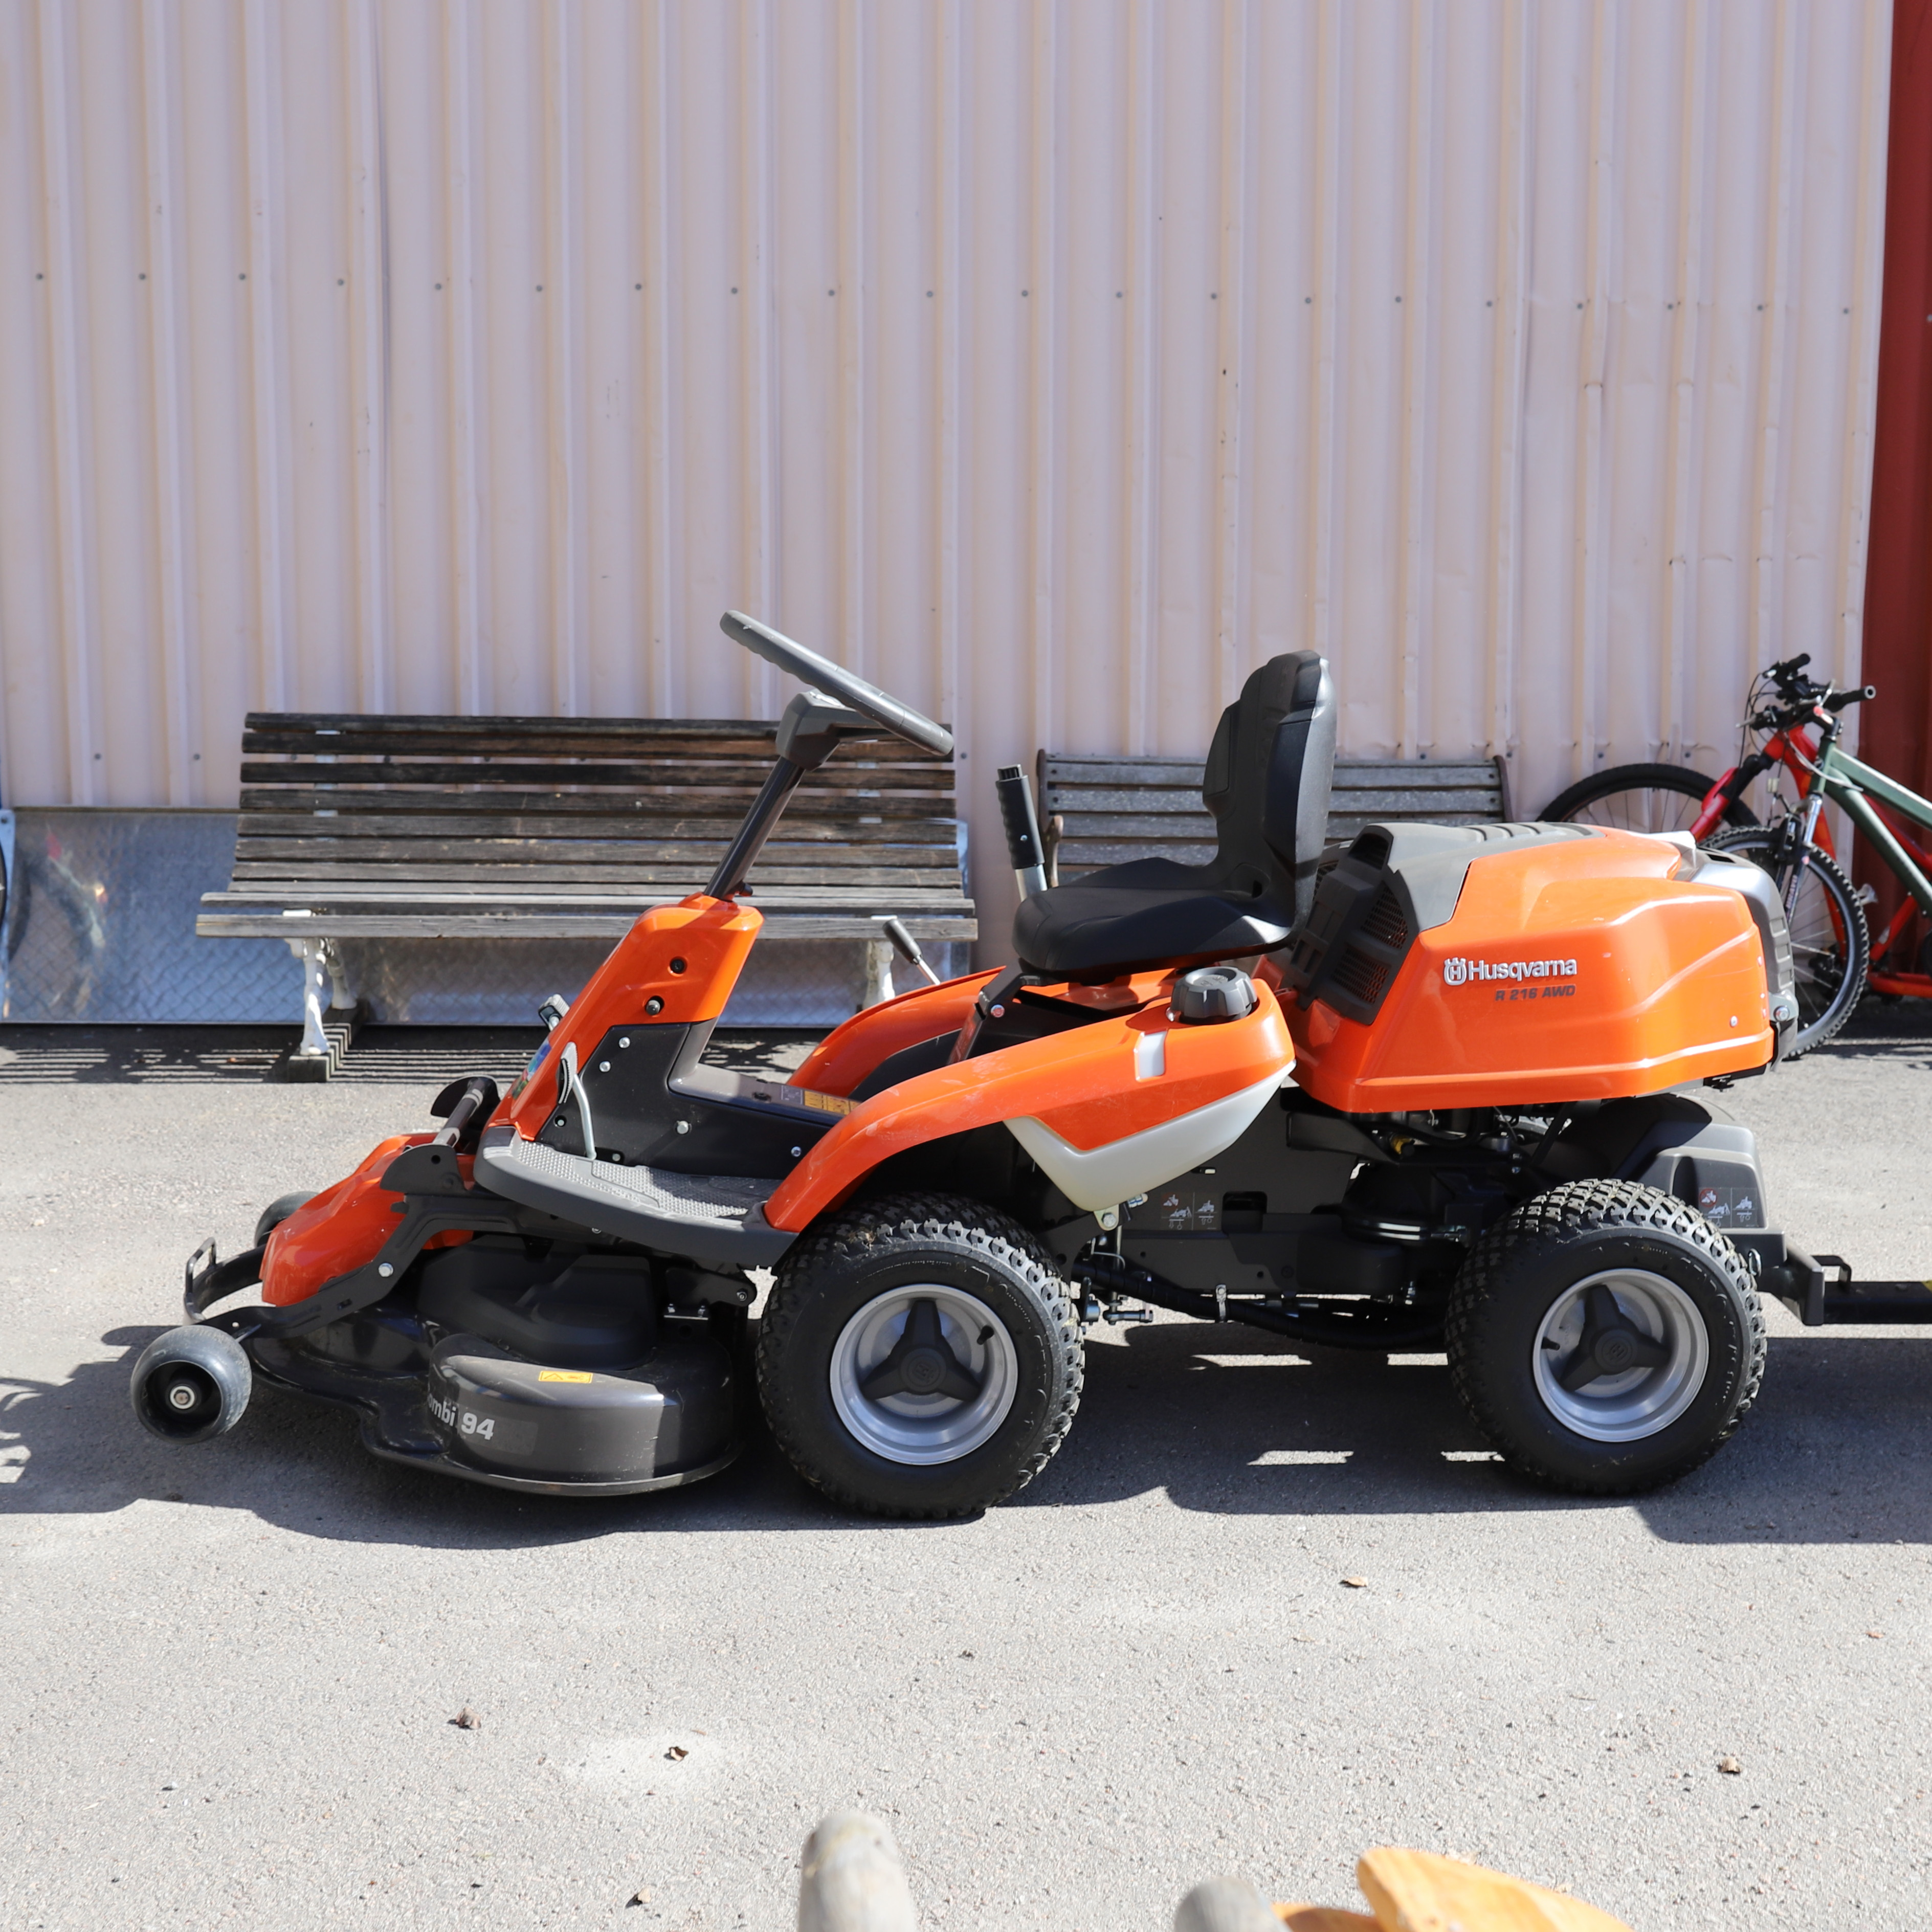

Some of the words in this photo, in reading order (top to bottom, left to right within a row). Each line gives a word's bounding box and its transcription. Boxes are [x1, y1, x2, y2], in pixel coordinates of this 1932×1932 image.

[1468, 959, 1577, 982] Husqvarna
[1495, 990, 1505, 1001] R
[1509, 988, 1538, 1001] 216
[1541, 985, 1576, 998] AWD
[427, 1393, 456, 1427] ombi
[461, 1412, 495, 1440] 94
